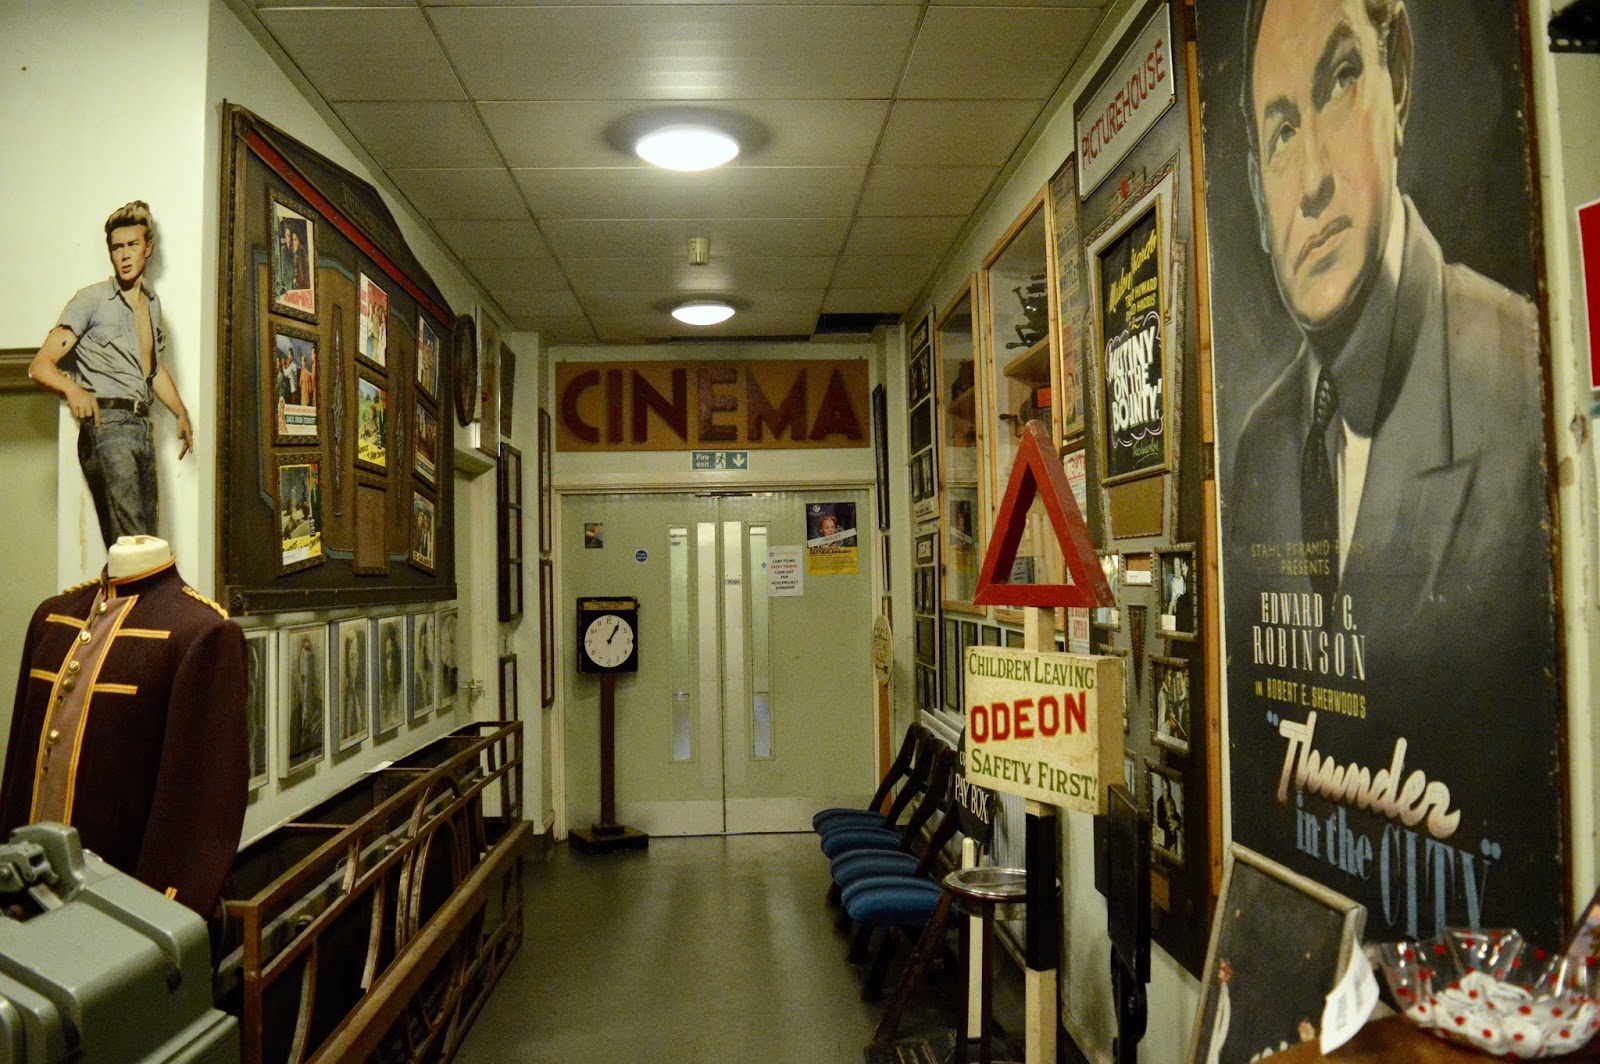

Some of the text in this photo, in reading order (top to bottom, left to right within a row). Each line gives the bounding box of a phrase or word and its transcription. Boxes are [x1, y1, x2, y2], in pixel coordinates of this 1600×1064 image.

[1082, 38, 1166, 170] PICTUREHOUSE
[1114, 362, 1150, 401] ON THE
[562, 367, 864, 444] CINEMA
[696, 453, 710, 461] Fire
[1251, 543, 1282, 558] STAHL
[1286, 540, 1330, 556] PYRAMID
[1281, 559, 1330, 576] PRESENTS
[1261, 592, 1323, 627] EDWARD
[969, 653, 1094, 690] CHILDREN LEAVING
[1253, 626, 1365, 681] ROBINSON
[1255, 681, 1263, 696] IN
[1267, 678, 1298, 703] ROBERT
[1301, 684, 1310, 706] E.
[970, 690, 1087, 744] ODEON
[971, 748, 1098, 801] SAFETY FIRST!
[955, 773, 990, 825] PAY BOX
[1296, 793, 1322, 860] in
[1326, 805, 1373, 880] the
